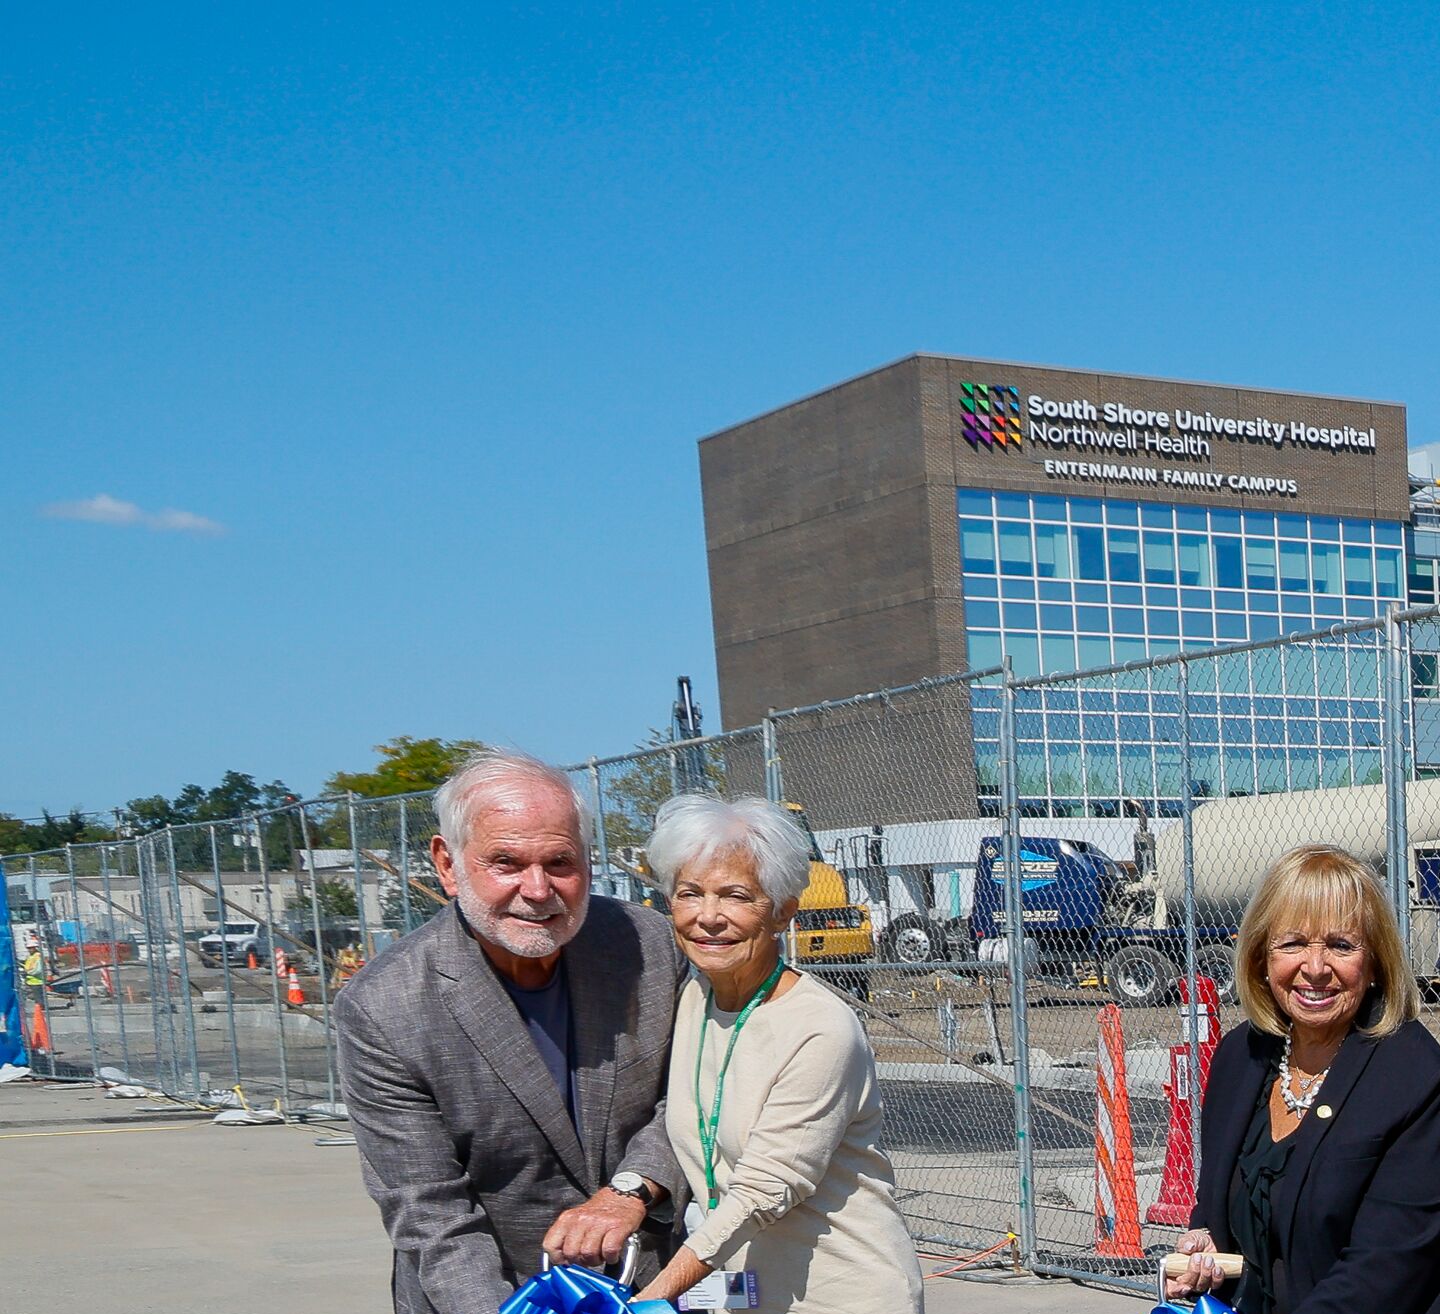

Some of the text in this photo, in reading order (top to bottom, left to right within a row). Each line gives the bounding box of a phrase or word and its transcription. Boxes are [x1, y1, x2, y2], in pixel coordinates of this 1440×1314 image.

[1028, 395, 1376, 448] South Shore University Hospital
[1030, 421, 1210, 456] Northwell Health
[1044, 459, 1298, 493] ENTENMANN FAMILY CAMPUS
